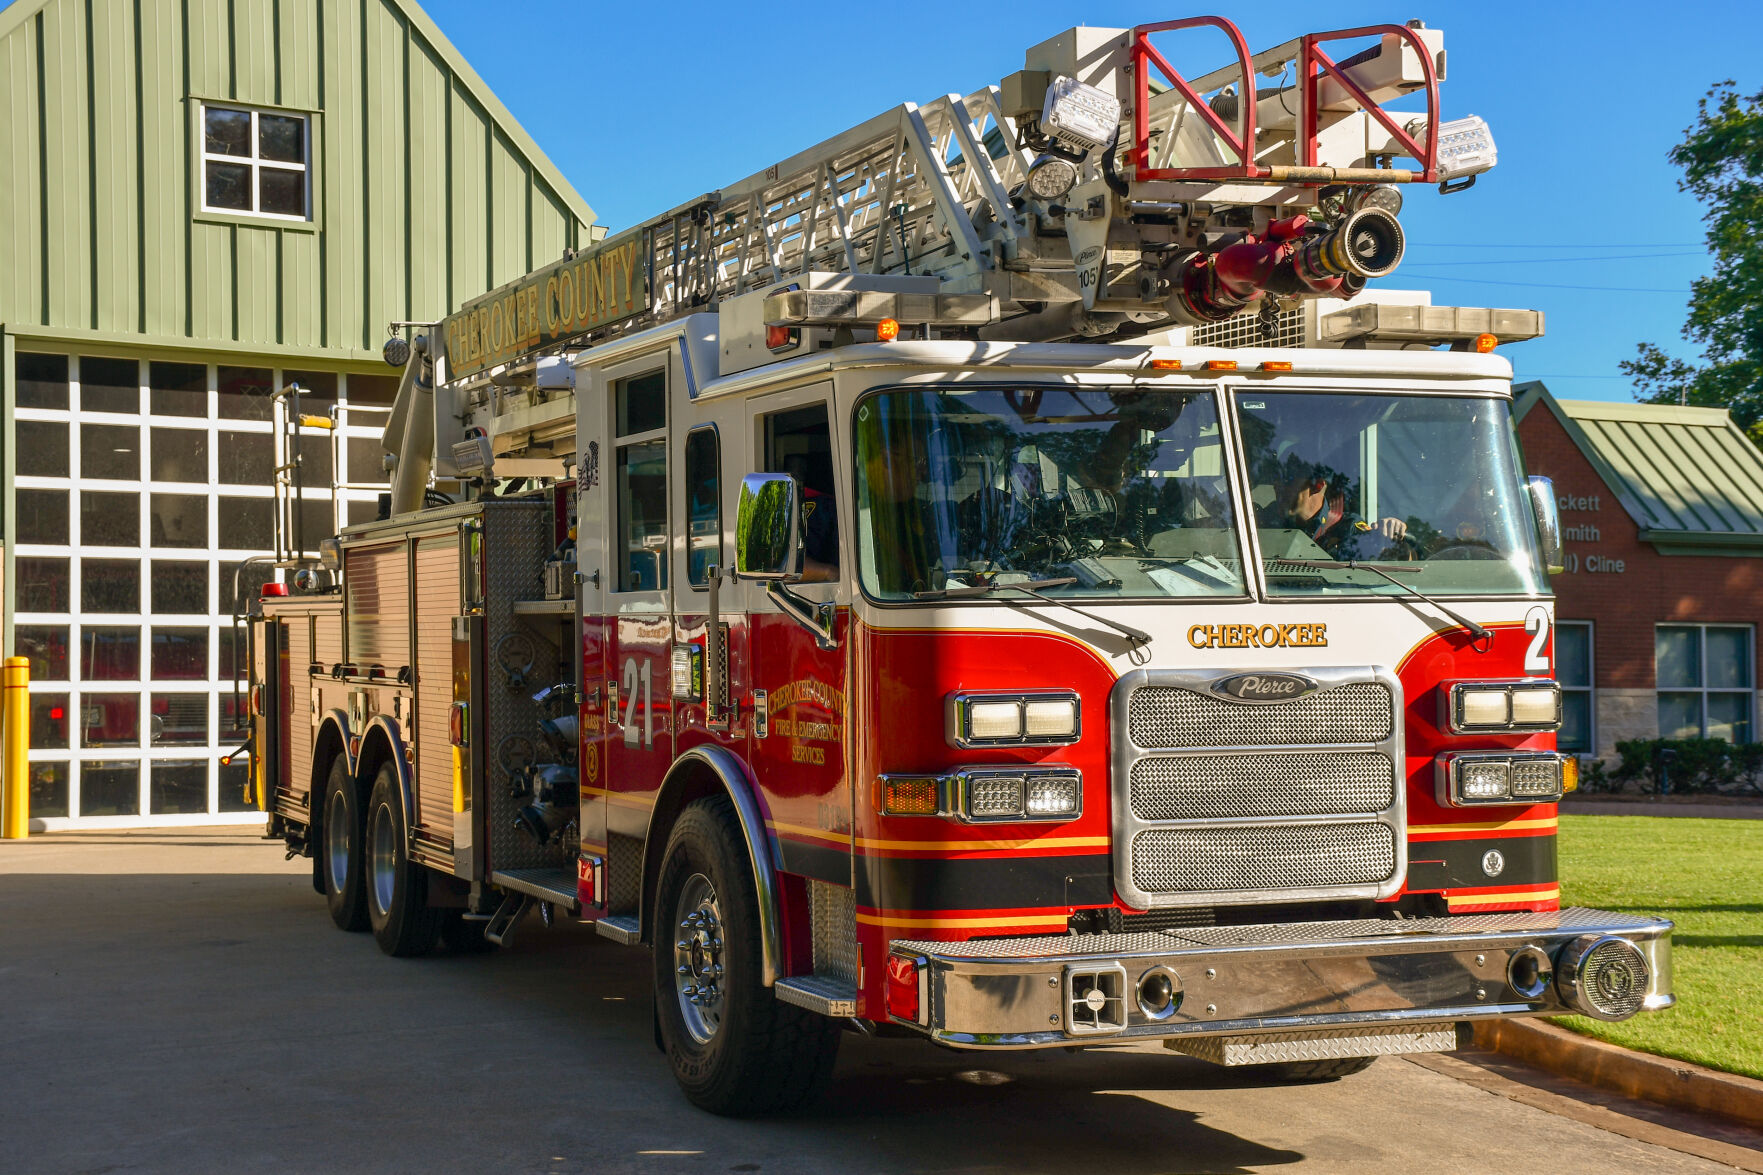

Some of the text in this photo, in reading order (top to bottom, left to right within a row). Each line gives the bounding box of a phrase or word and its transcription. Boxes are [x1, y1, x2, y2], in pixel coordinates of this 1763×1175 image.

[448, 241, 636, 374] CHEROKEE COUNTY
[1563, 524, 1601, 542] mith
[1585, 554, 1625, 573] Cline
[1187, 622, 1329, 649] CHEROKEE
[1524, 606, 1551, 675] 2
[768, 680, 812, 715] CHEROKEE
[1239, 676, 1296, 697] Pierce
[623, 657, 654, 750] 21
[775, 719, 842, 742] FIRE & EMERGENCY
[792, 745, 825, 765] SERVICES
